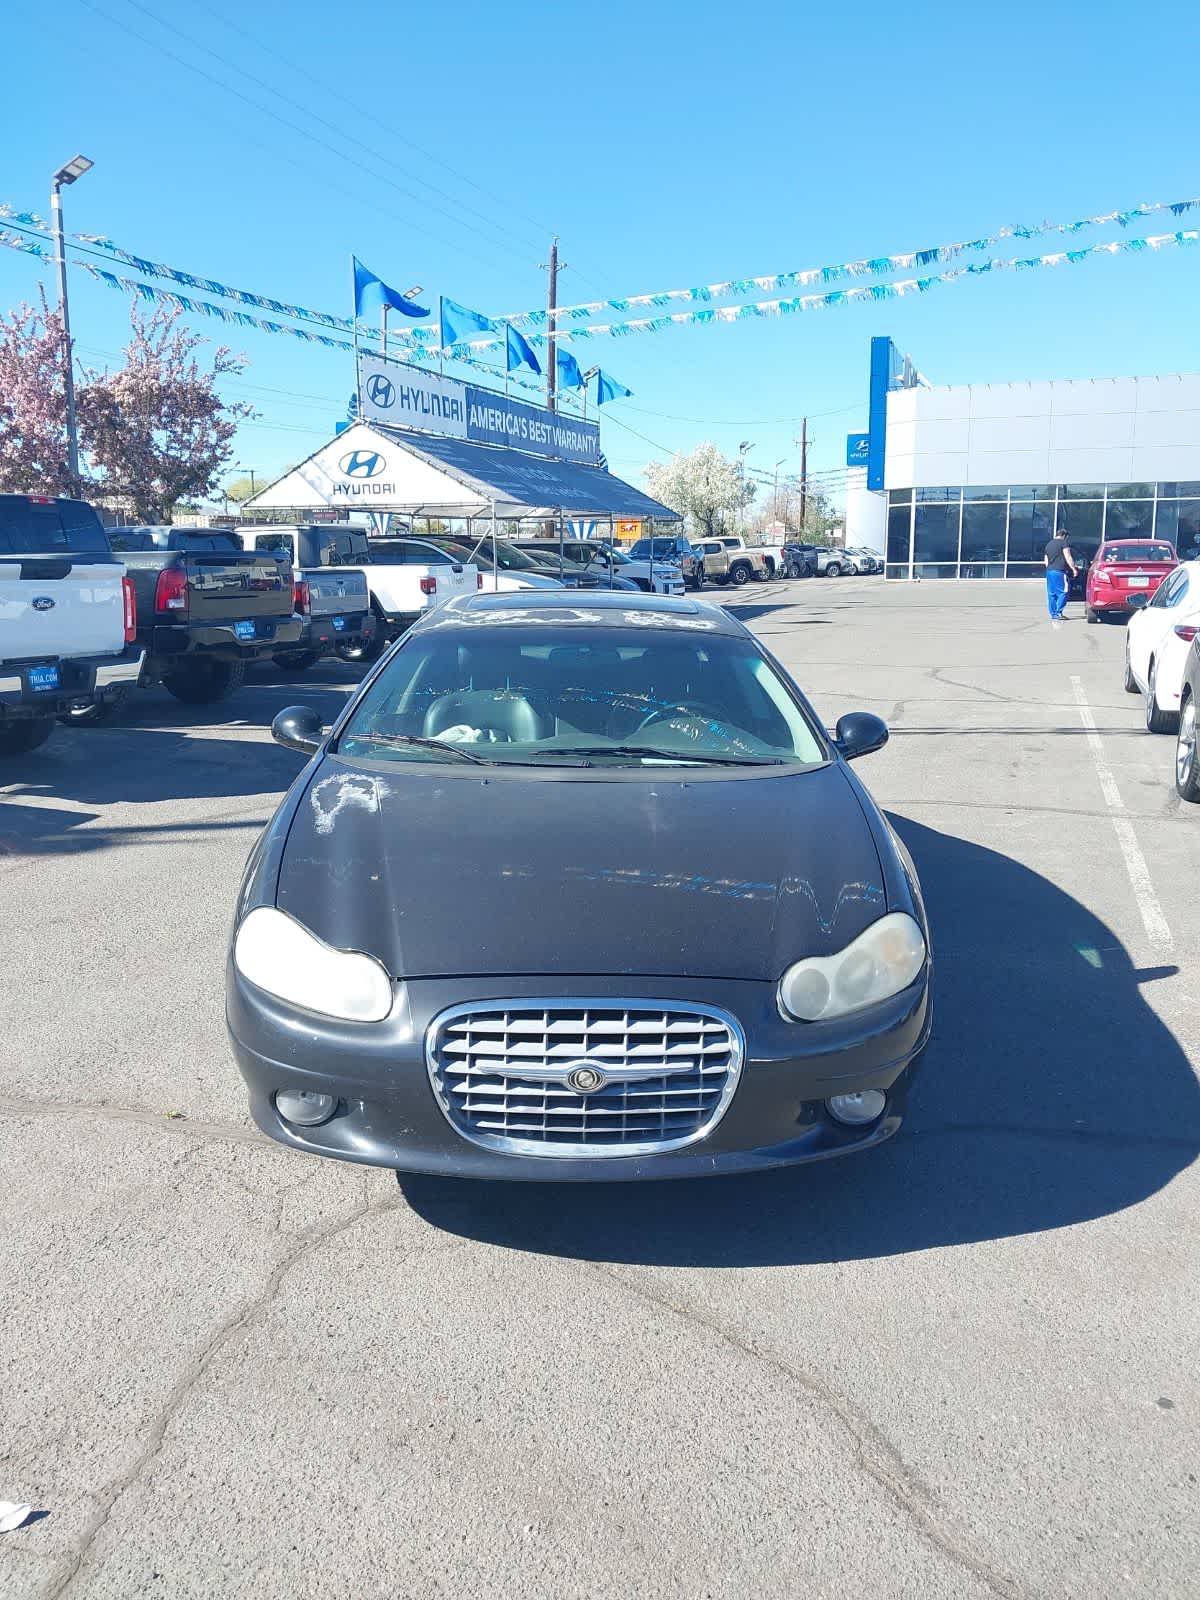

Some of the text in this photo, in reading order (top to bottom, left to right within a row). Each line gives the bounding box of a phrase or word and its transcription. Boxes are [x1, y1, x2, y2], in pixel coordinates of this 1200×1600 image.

[400, 384, 463, 423] HYUNDAI
[469, 404, 597, 454] AMERICA'S BEST WARRANTY
[333, 483, 395, 496] HYUNDAI
